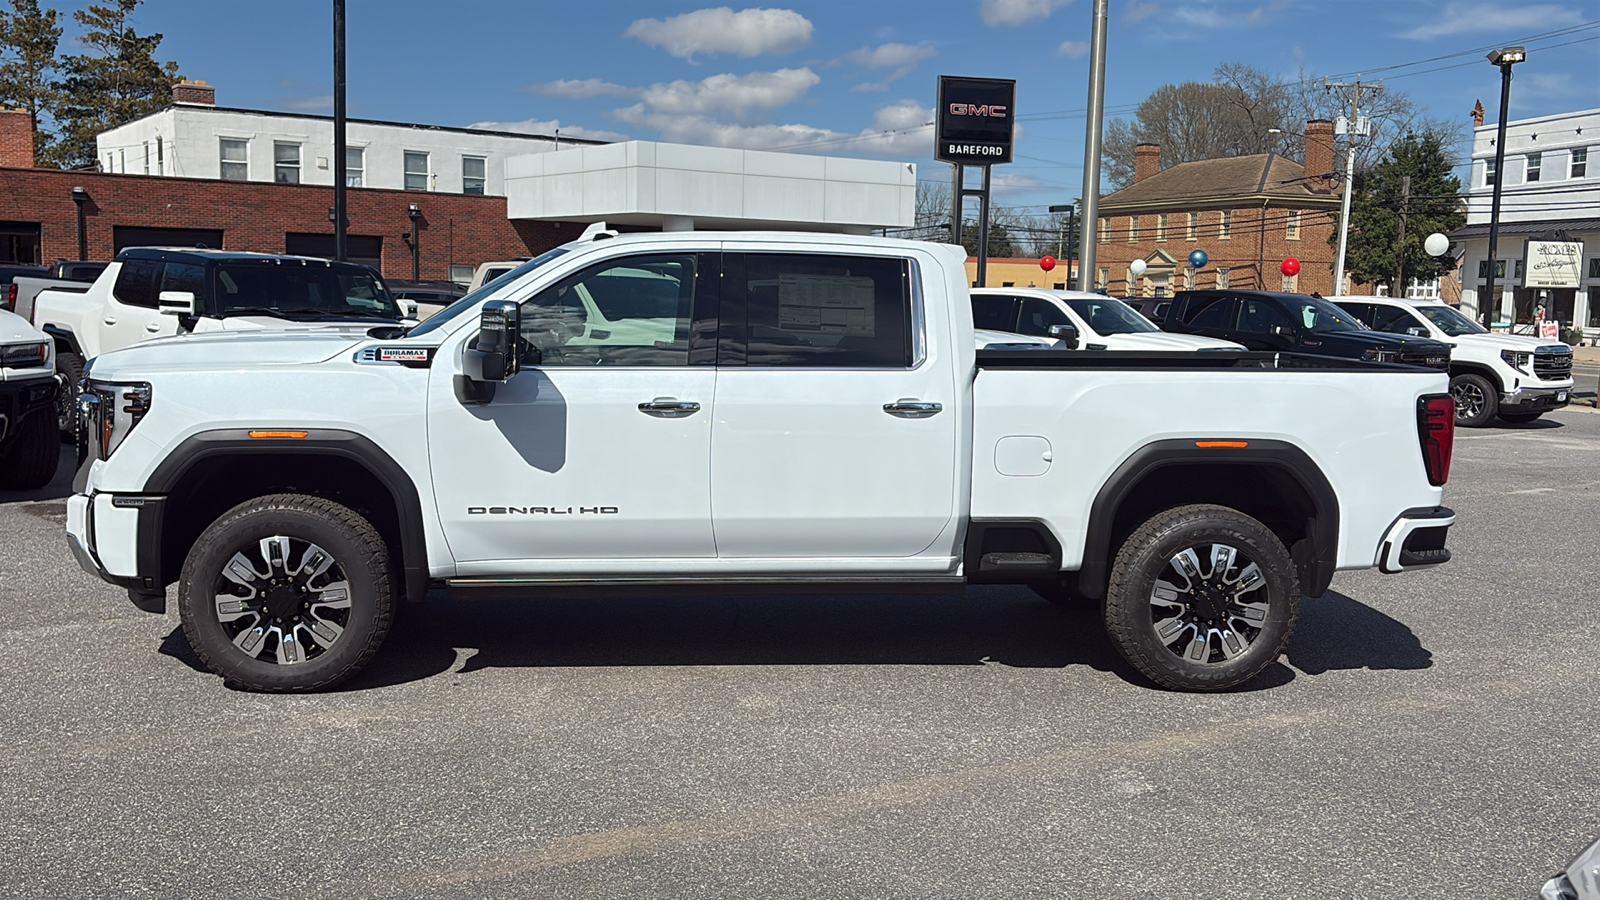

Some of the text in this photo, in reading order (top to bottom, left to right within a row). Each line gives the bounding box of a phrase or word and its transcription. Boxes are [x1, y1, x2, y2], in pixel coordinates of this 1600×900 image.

[950, 103, 1006, 117] GMC
[949, 144, 1003, 156] BAREFORD
[467, 506, 619, 515] DENALI HD
